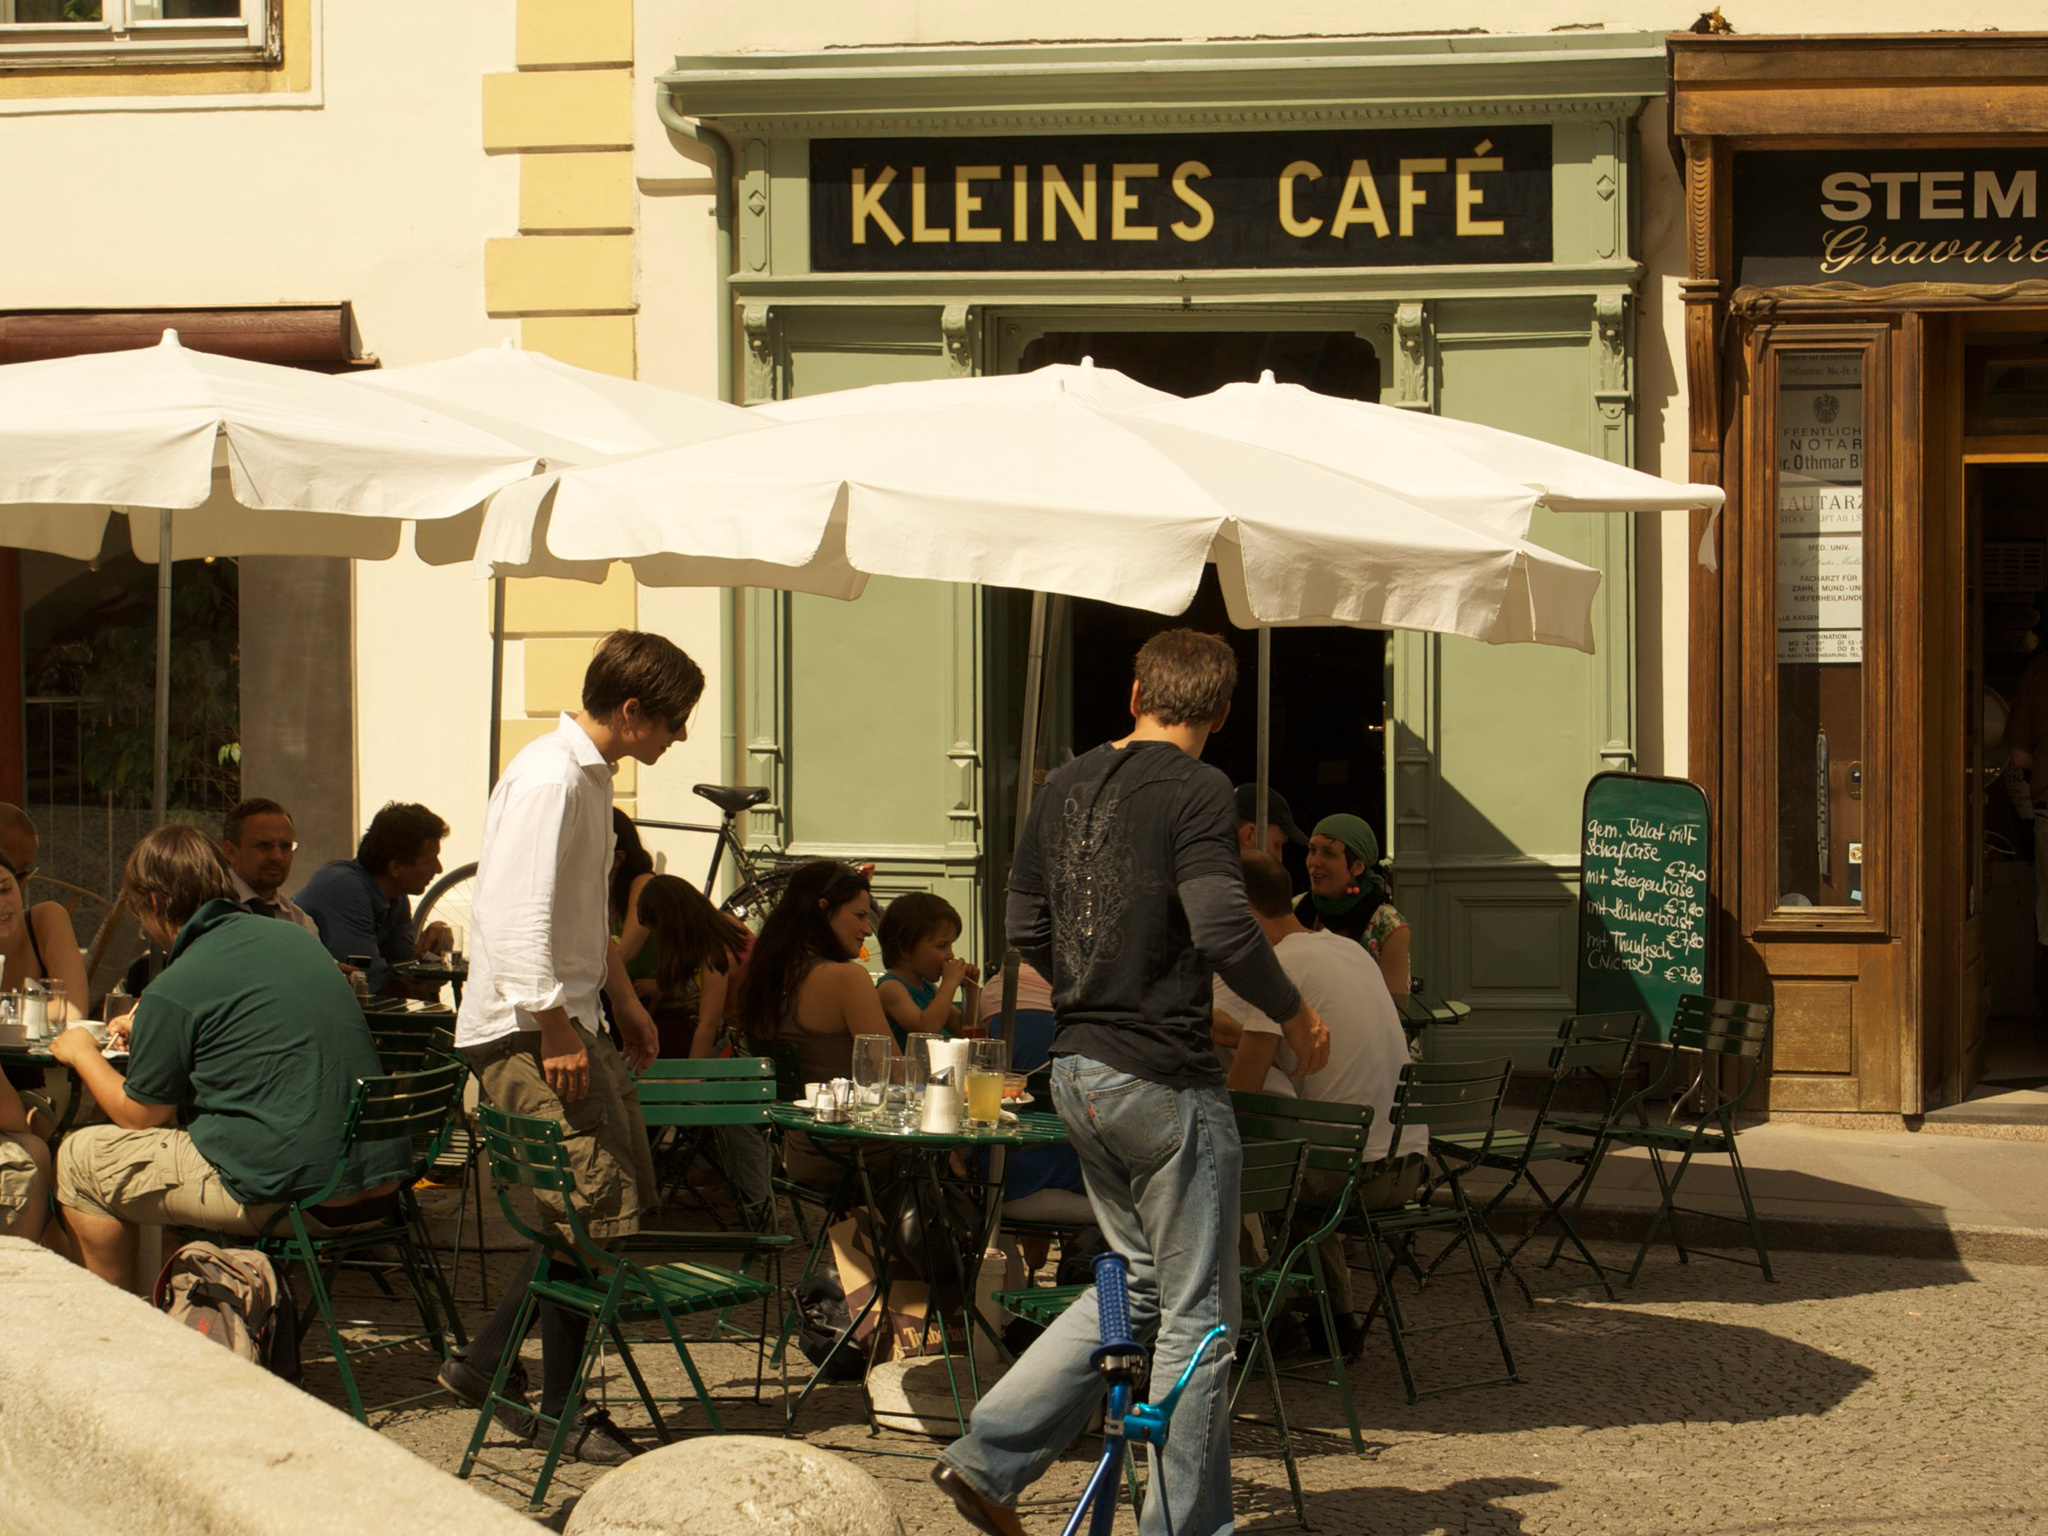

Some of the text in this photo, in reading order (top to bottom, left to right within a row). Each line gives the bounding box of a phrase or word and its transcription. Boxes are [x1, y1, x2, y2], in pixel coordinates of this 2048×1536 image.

[851, 138, 1505, 246] KLEINES CAFÉ
[1820, 170, 2037, 221] STEM
[1790, 438, 1862, 451] NOTAR
[1794, 454, 1846, 471] Othmar
[1850, 453, 1862, 469] B
[1808, 544, 1850, 552] MED. UNIV.
[1627, 818, 1665, 840] Salat
[1586, 867, 1609, 885] mit
[1586, 931, 1609, 948] mit
